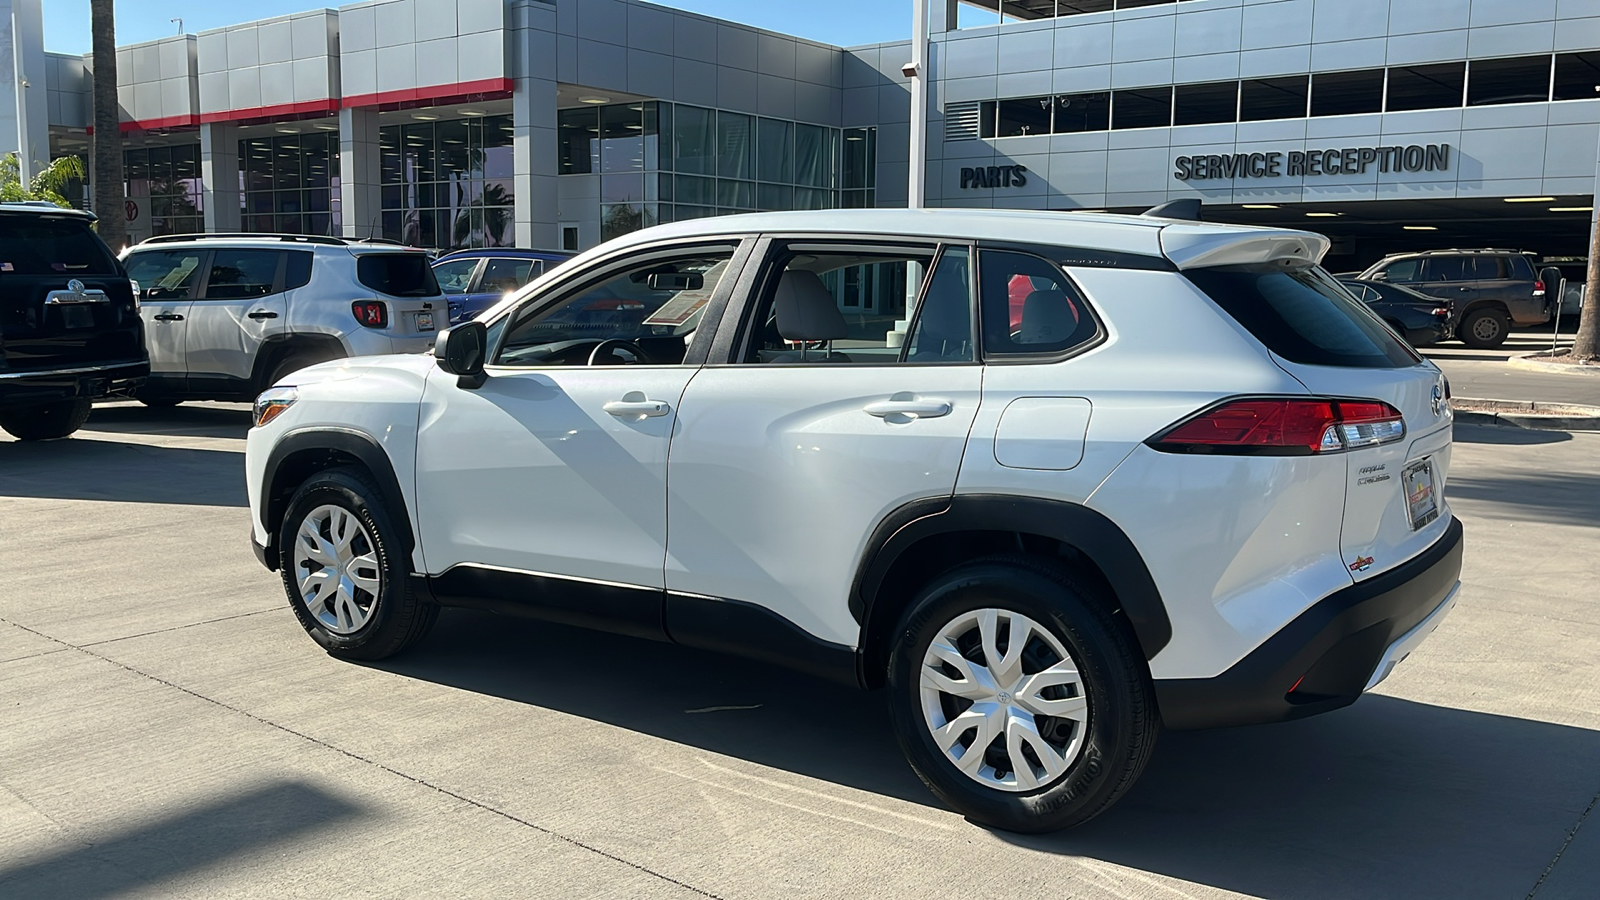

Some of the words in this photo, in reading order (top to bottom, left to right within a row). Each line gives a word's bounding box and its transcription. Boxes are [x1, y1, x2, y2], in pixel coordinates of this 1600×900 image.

[960, 165, 1027, 189] PARTS
[1174, 152, 1282, 180] SERVICE
[1286, 144, 1449, 176] RECEPTION
